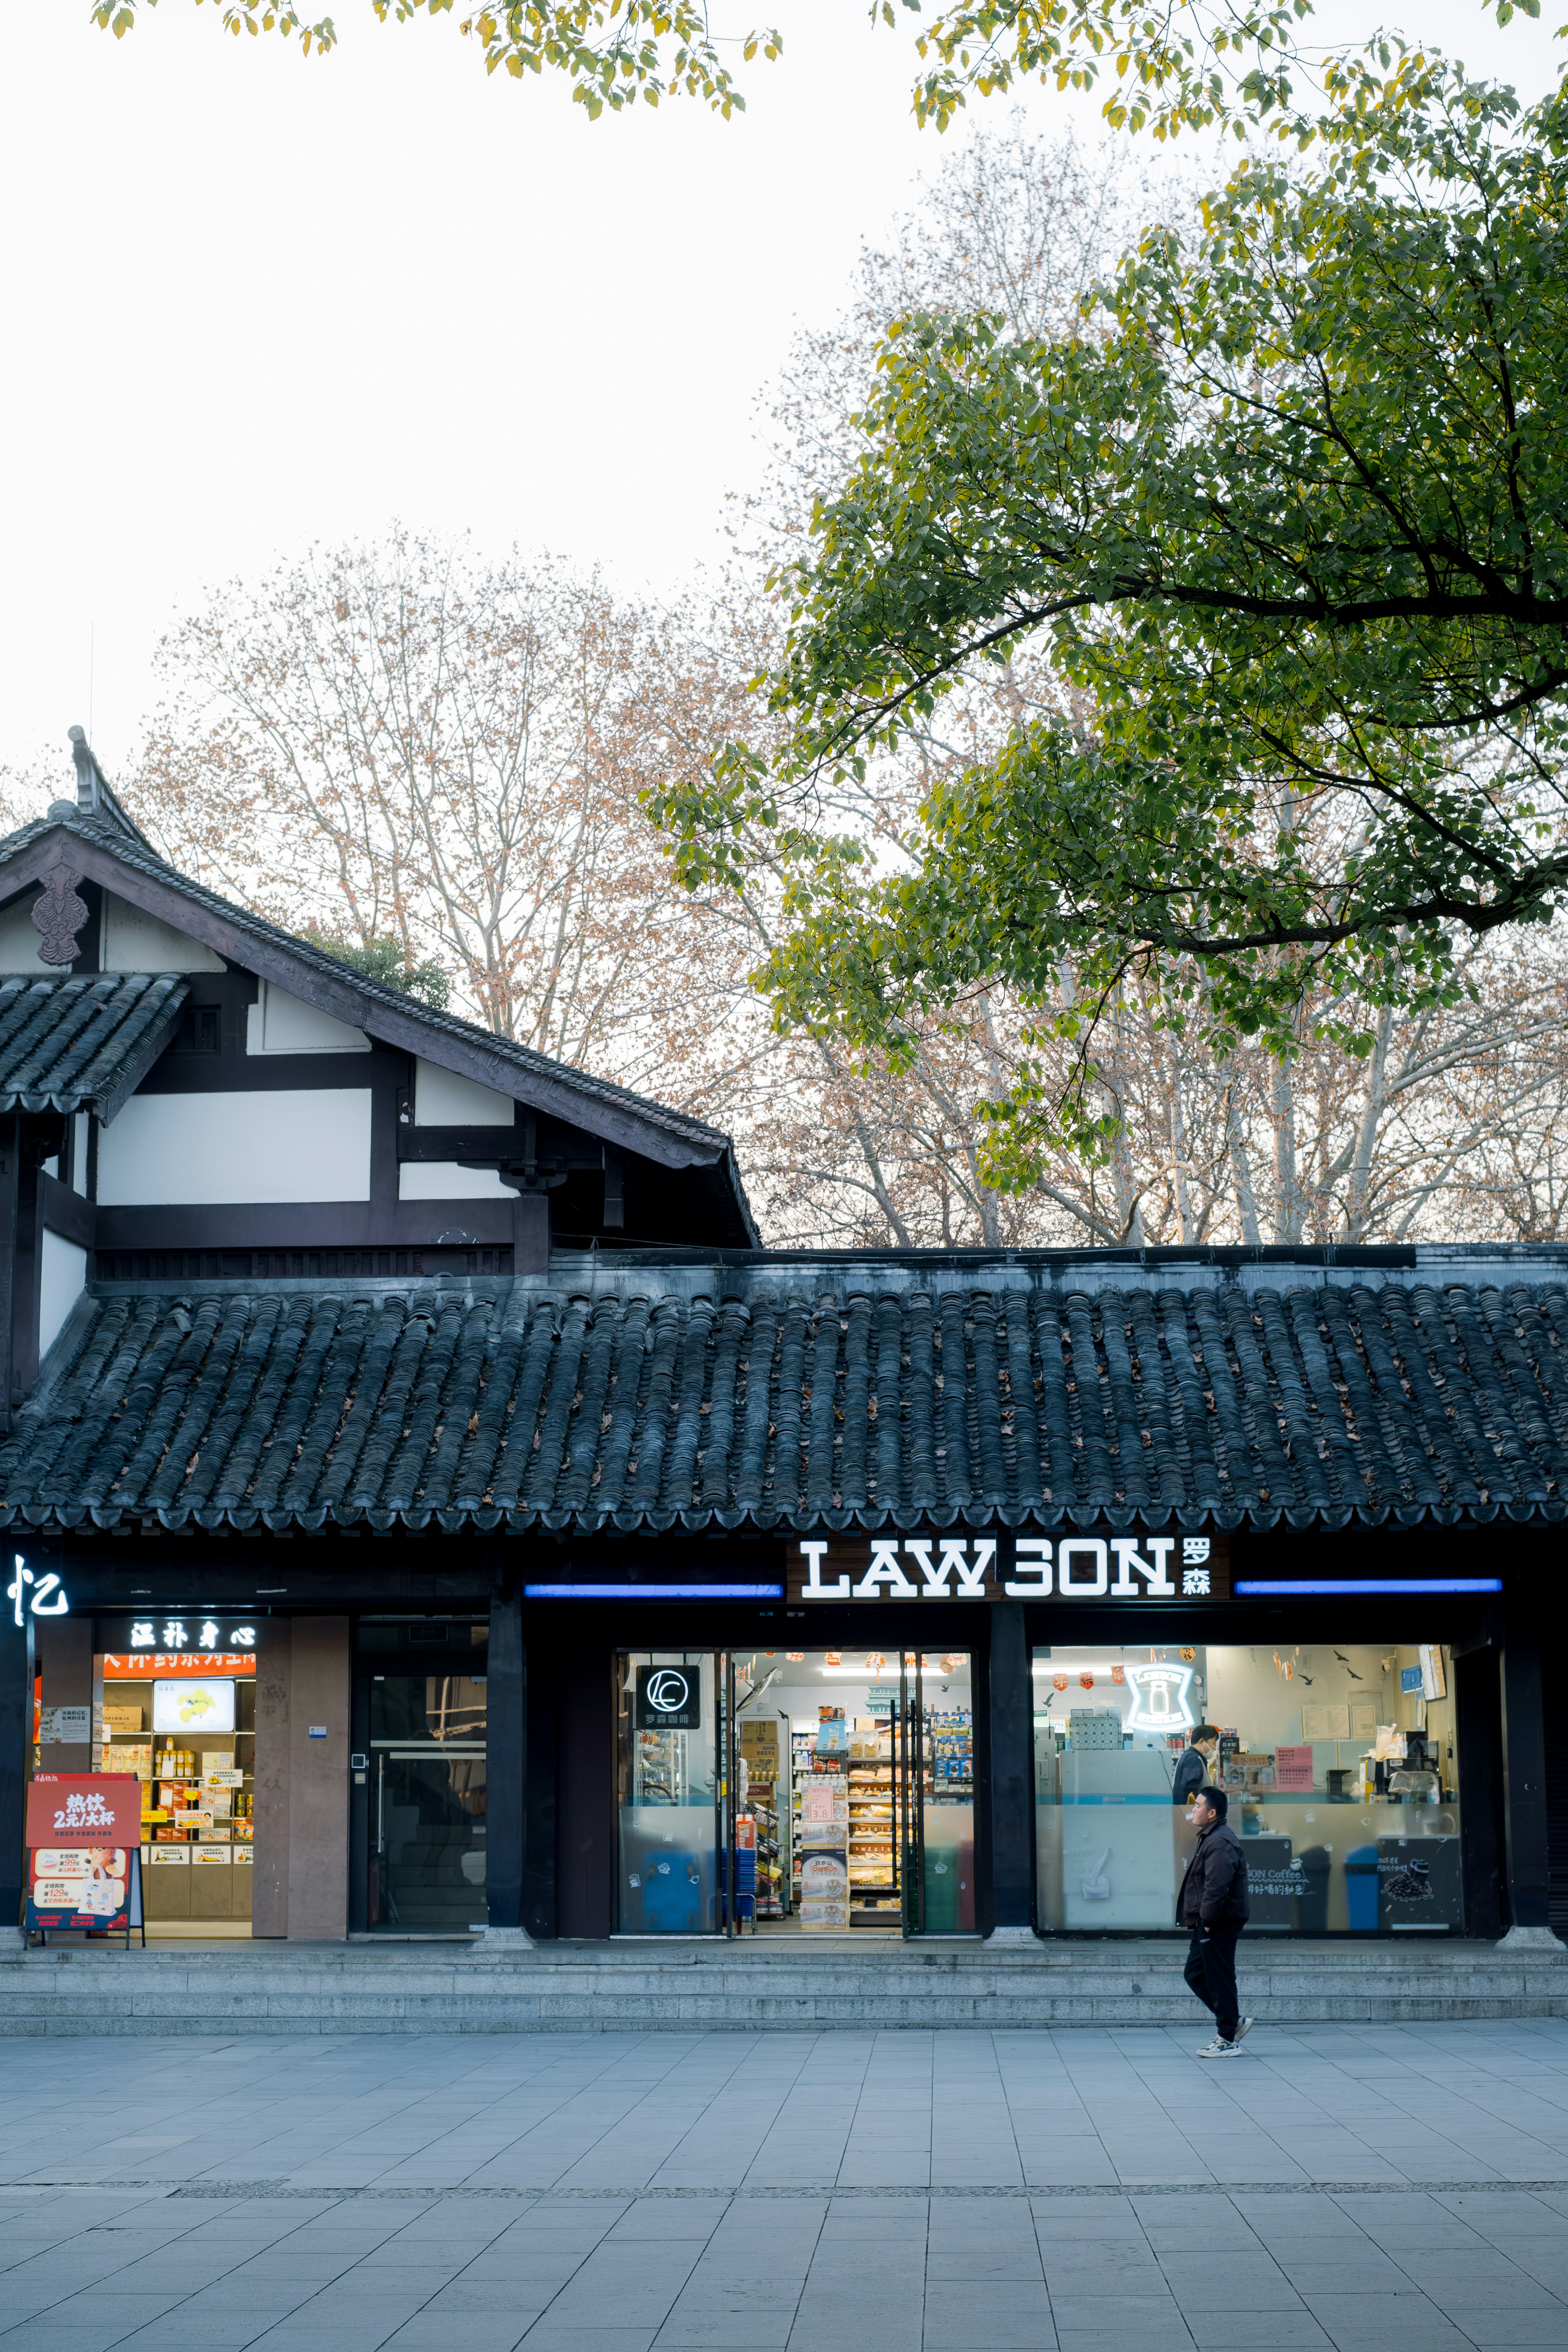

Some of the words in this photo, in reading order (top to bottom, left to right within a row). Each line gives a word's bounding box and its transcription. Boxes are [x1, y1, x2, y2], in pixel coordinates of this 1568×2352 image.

[800, 1538, 1175, 1598] LAWSON
[1183, 1538, 1210, 1595] 罗森
[7, 1554, 69, 1627] 忆
[131, 1621, 255, 1649] 温补身心
[1055, 1676, 1067, 1687] 年
[1081, 1674, 1092, 1685] 快
[645, 1715, 690, 1724] 罗森咖啡
[66, 1793, 106, 1813] 热饮
[53, 1811, 116, 1829] 2元/大杯
[1268, 1869, 1301, 1879] Coffee
